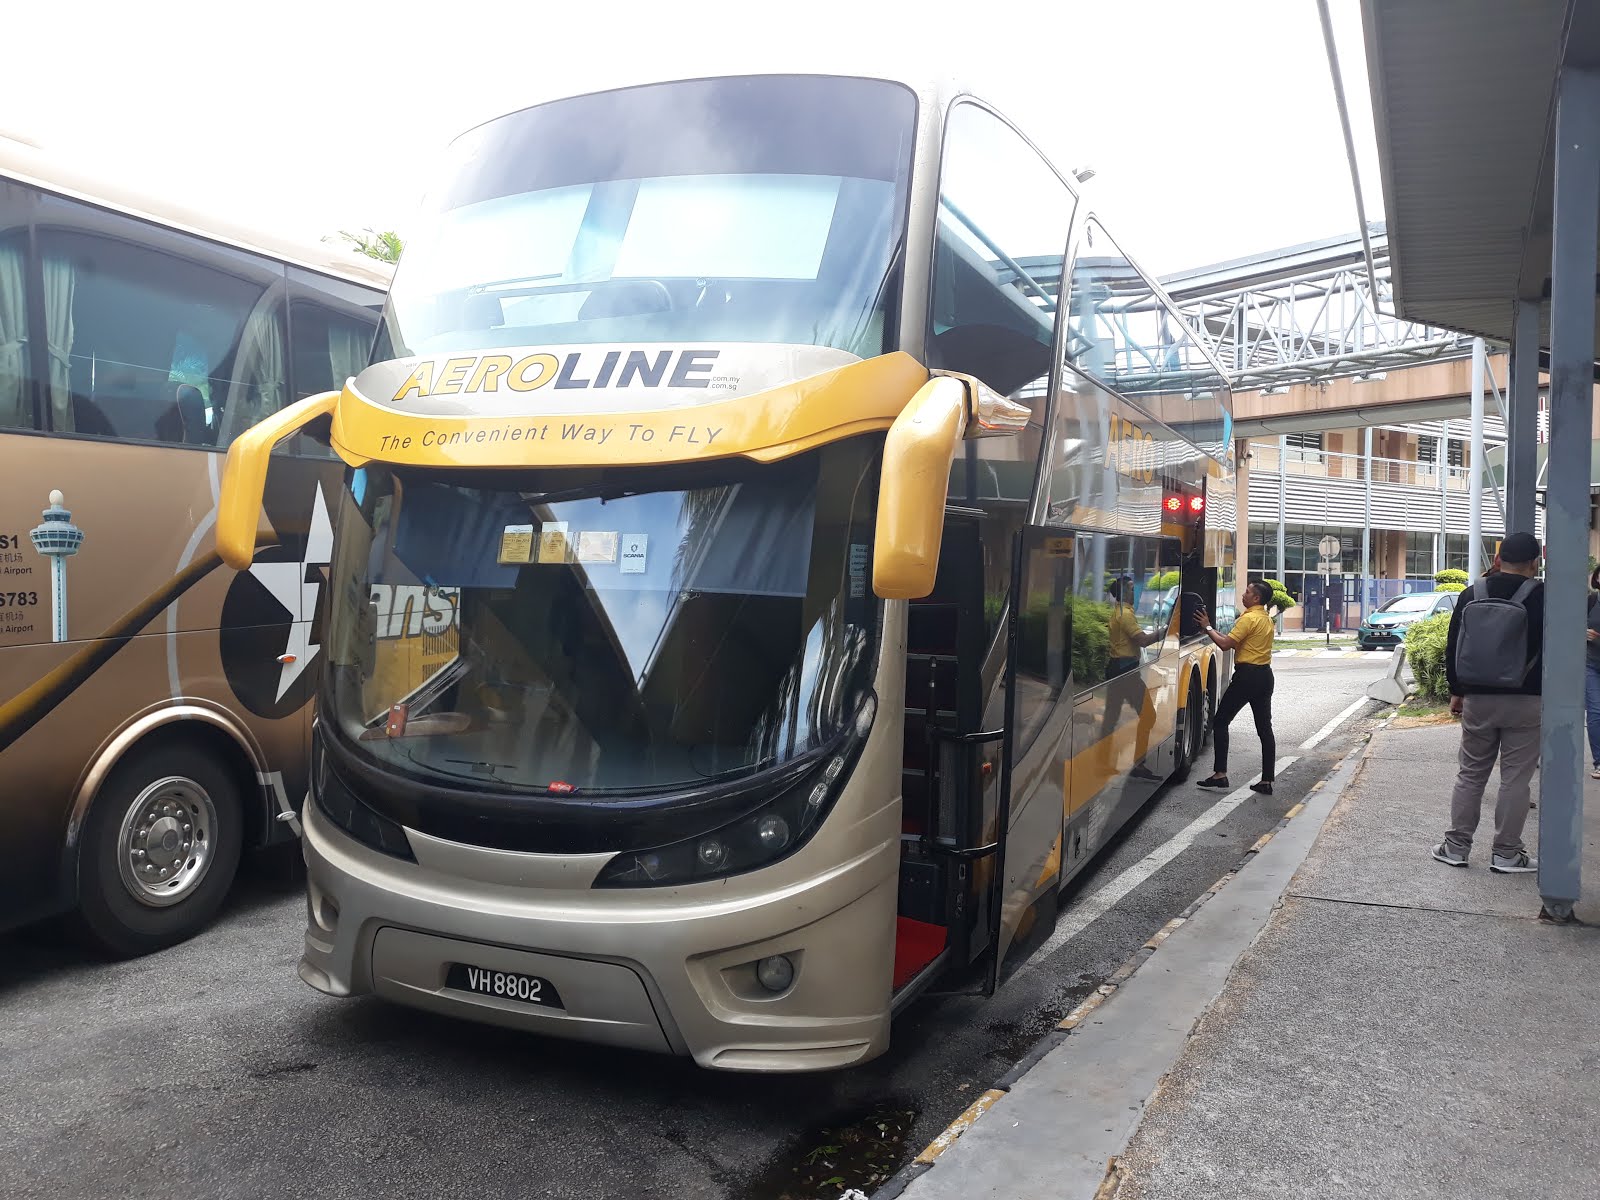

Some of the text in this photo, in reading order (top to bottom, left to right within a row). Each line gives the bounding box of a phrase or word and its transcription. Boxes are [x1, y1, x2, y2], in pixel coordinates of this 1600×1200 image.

[392, 350, 720, 401] AEROLINE
[380, 423, 723, 452] The Convenient Way To FLY
[4, 567, 32, 575] Airport
[6, 624, 34, 634] Airport
